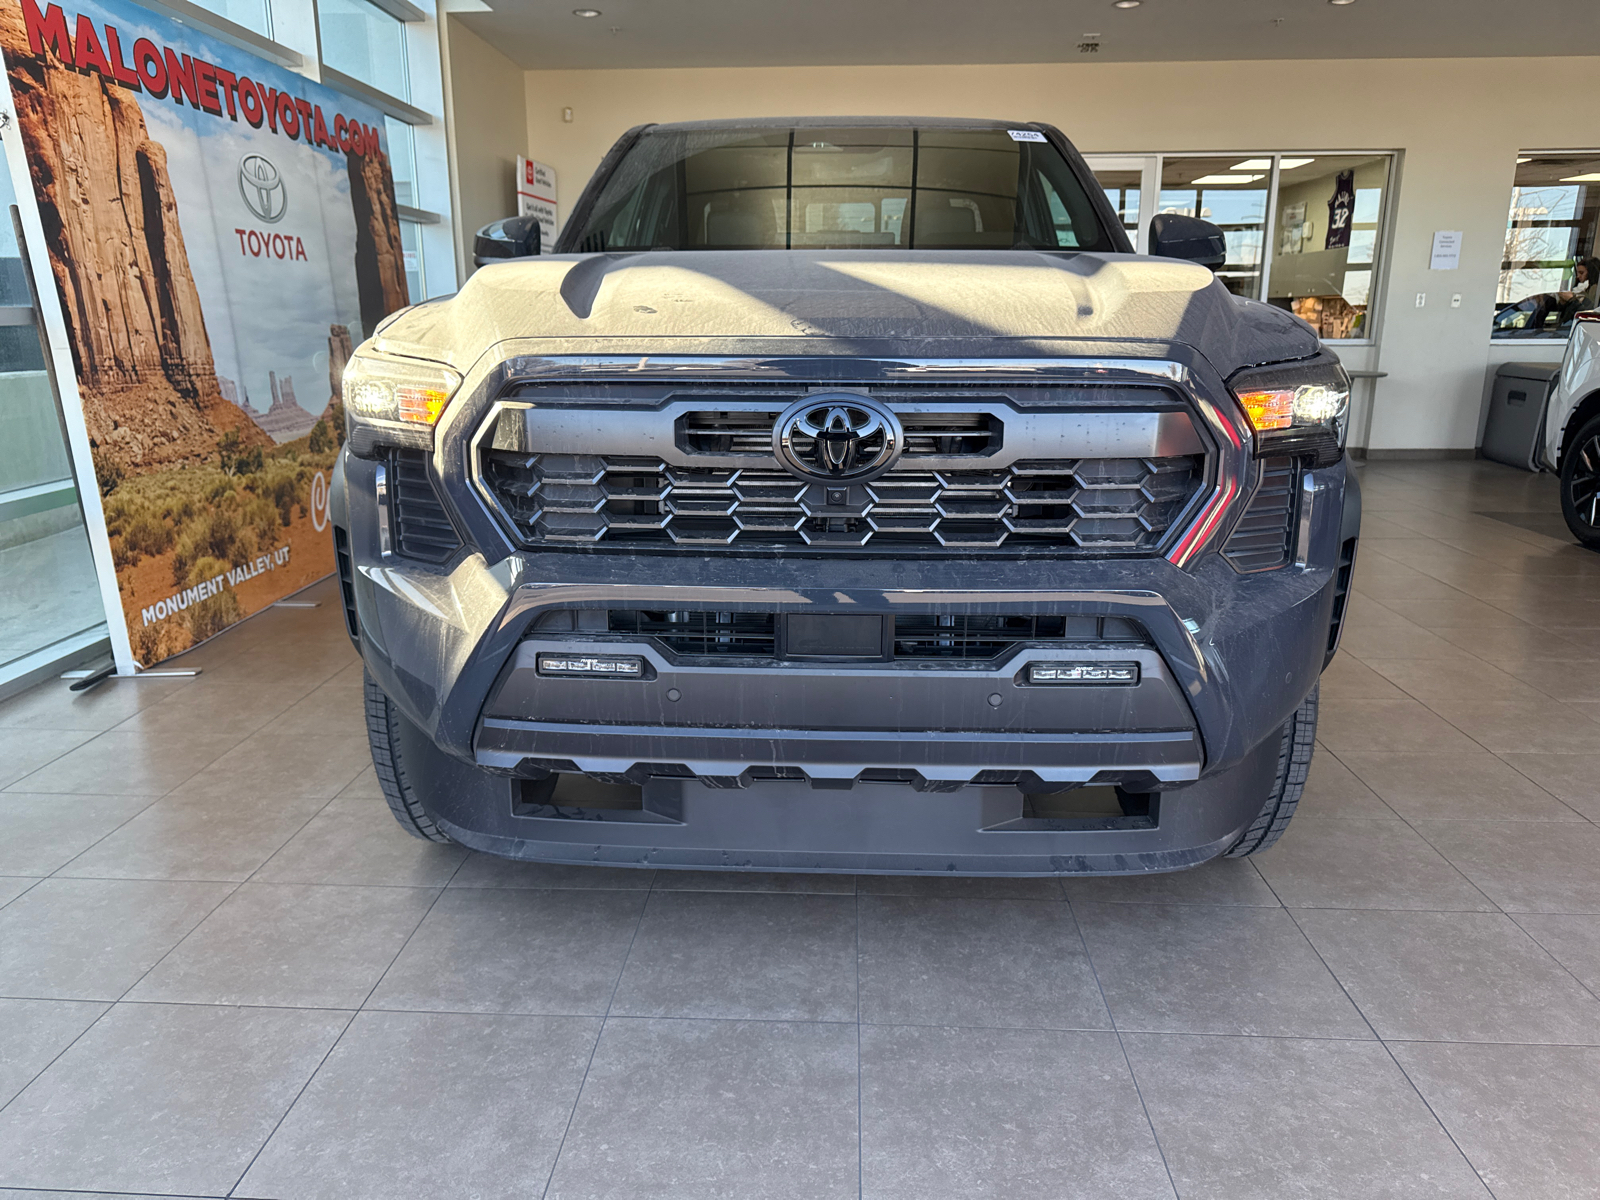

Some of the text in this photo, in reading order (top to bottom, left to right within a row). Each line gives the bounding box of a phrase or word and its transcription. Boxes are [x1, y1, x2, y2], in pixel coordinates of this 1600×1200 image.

[22, 0, 384, 160] MALONETOYOTA.COM
[235, 228, 308, 262] TOYOTA
[1332, 208, 1349, 229] 32
[141, 546, 289, 627] MONUMENT VALLEY, UT
